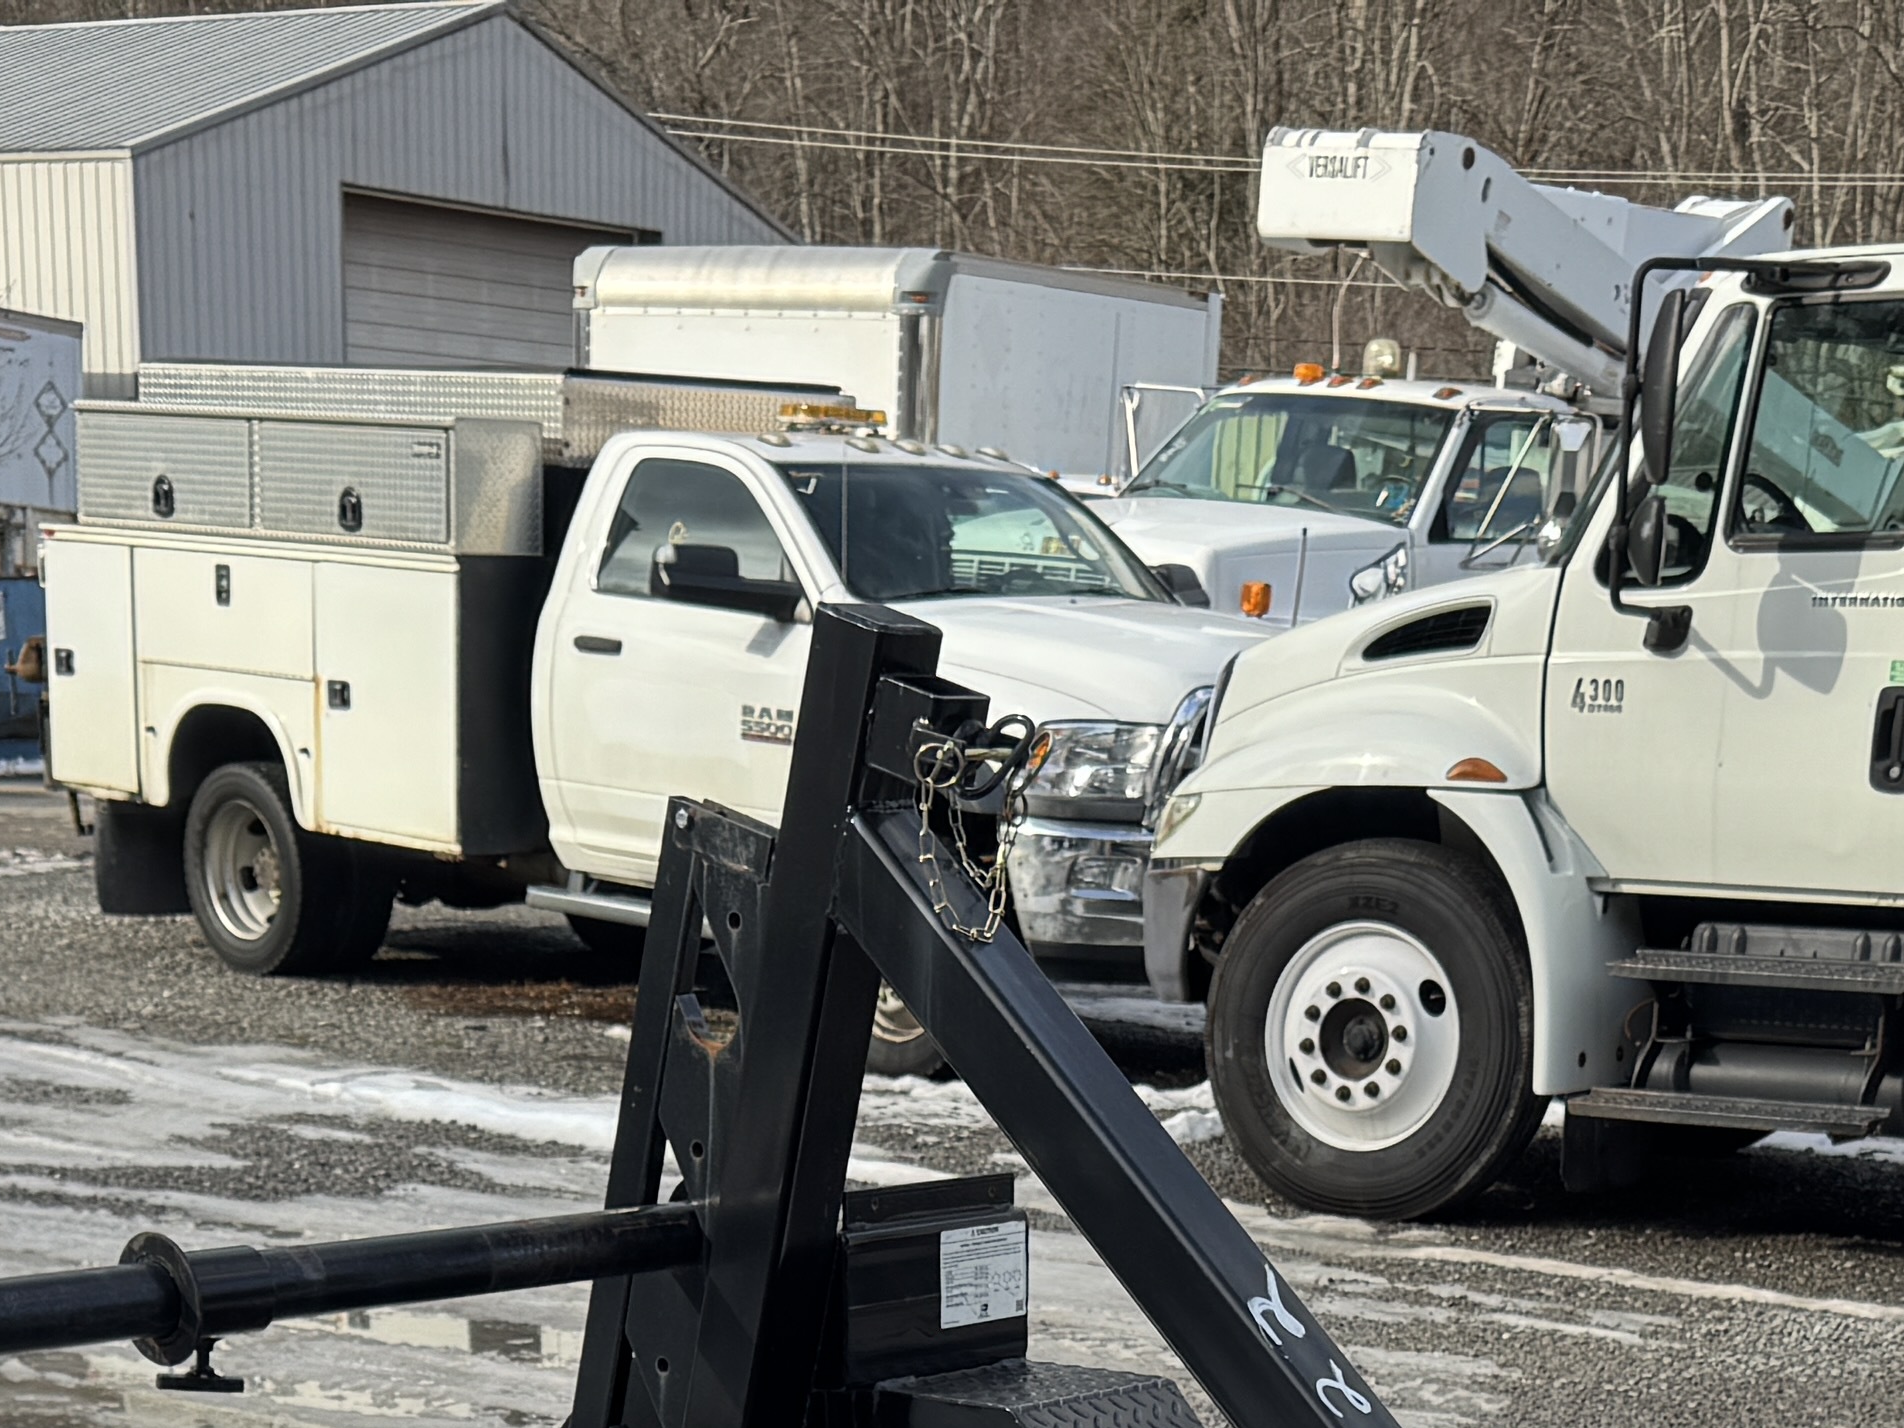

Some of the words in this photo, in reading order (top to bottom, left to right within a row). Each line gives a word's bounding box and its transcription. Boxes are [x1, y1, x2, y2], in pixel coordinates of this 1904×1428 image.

[1571, 677, 1624, 713] 4300
[741, 704, 794, 723] RAM
[741, 719, 793, 737] 5500
